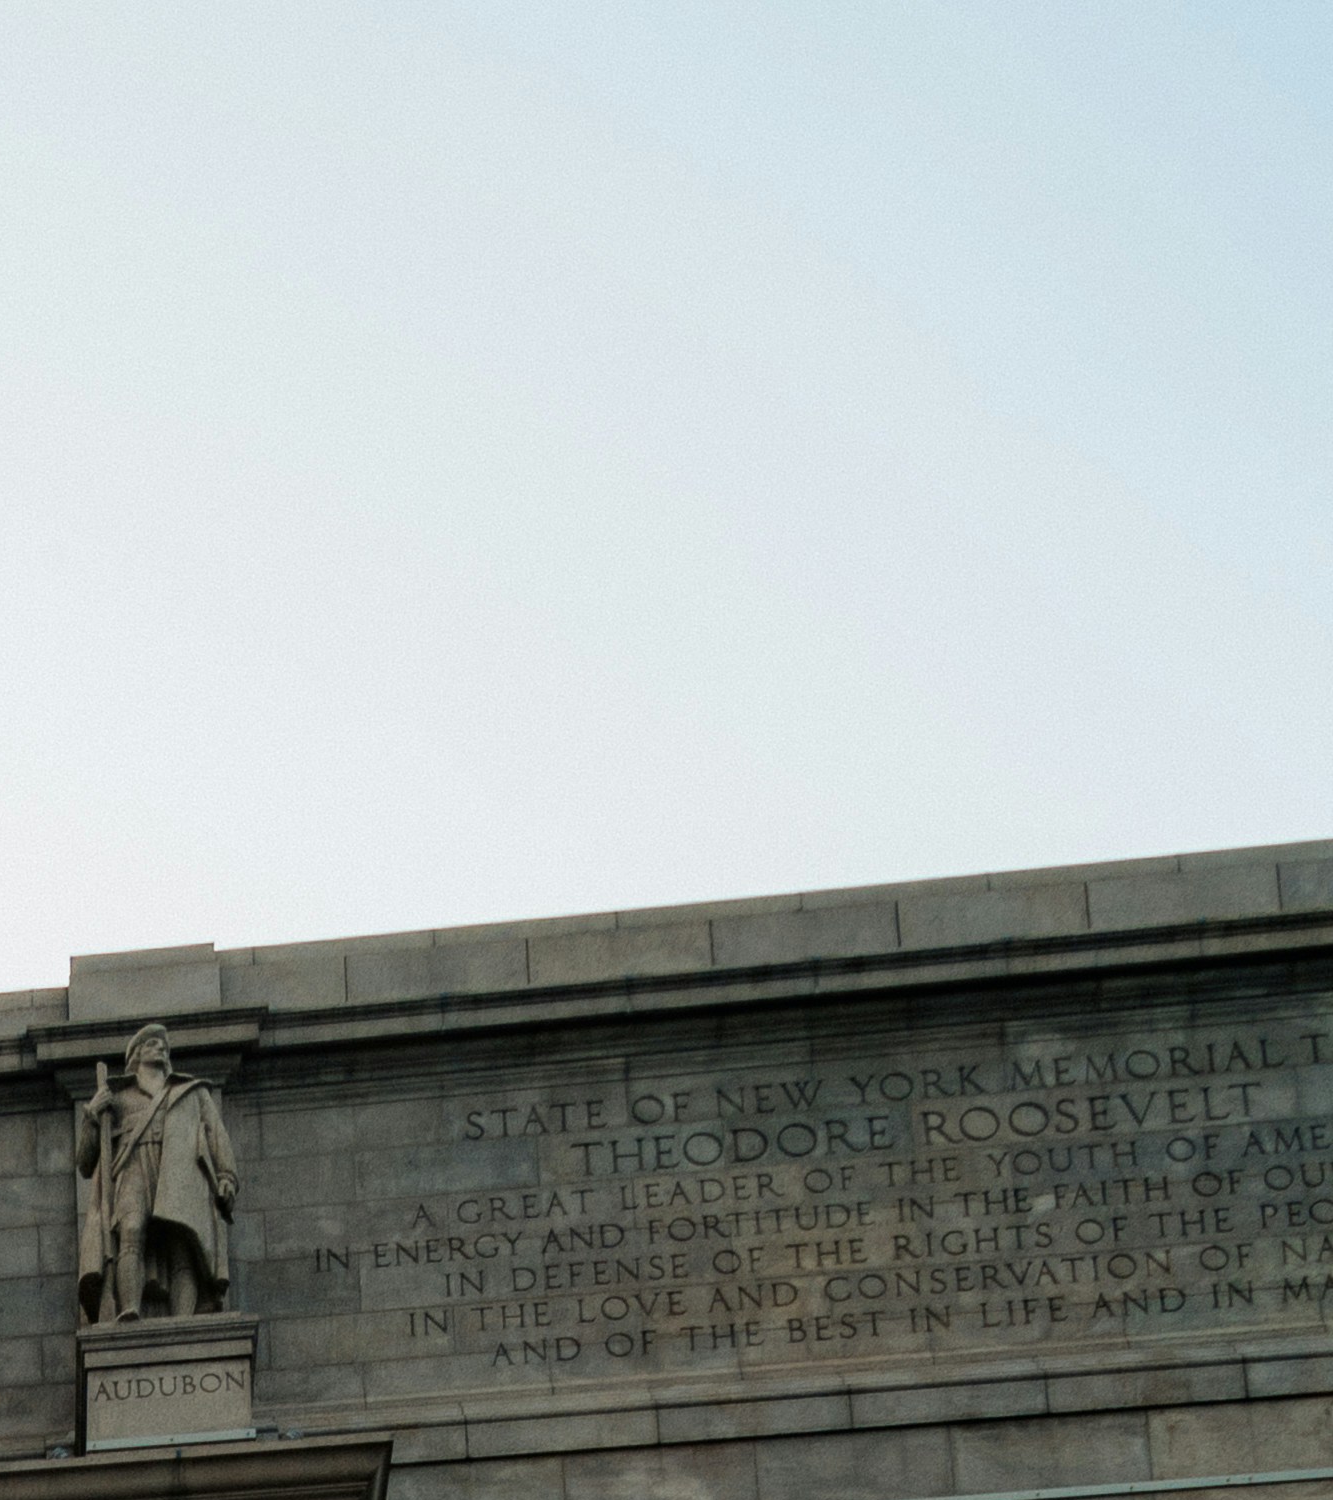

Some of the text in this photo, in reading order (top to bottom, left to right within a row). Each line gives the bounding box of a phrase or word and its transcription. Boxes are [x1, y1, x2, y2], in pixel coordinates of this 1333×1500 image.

[465, 1099, 608, 1141] STATE
[632, 1092, 692, 1127] OF
[717, 1079, 824, 1118] NEW
[850, 1065, 988, 1102] YORK
[1009, 1038, 1285, 1092] MEMORIAL
[571, 1082, 1262, 1177] THEODORE ROOSEVELT
[314, 1161, 1333, 1274] IN ENERGY AND FORTITUDE IN THE FAITH OF OU
[413, 1203, 434, 1230] A
[458, 1188, 595, 1225] GREAT
[621, 1171, 785, 1211] LEADER
[803, 1166, 856, 1194] OF
[879, 1157, 962, 1188] THE
[988, 1139, 1138, 1177] YOUTH
[1165, 1134, 1220, 1163] OF
[410, 1309, 450, 1337] IN
[472, 1302, 553, 1332] THE
[577, 1291, 688, 1324] LOVE
[708, 1281, 798, 1314] AND
[824, 1248, 1173, 1303] CONSERVATION
[1199, 1243, 1253, 1271] OF
[445, 1270, 485, 1298] IN
[512, 1253, 690, 1293] DEFENSE
[712, 1247, 763, 1276] OF
[785, 1234, 868, 1270] THE
[892, 1222, 1053, 1263] RIGHTS
[1075, 1215, 1128, 1245] OF
[1149, 1207, 1235, 1238] THE
[492, 1336, 582, 1367] AND
[605, 1330, 658, 1360] OF
[681, 1321, 765, 1352] THE
[788, 1311, 882, 1343] BEST
[910, 1305, 952, 1334] IN
[979, 1297, 1069, 1329] LIFE
[1092, 1287, 1186, 1319] AND
[1212, 1280, 1254, 1309] IN
[93, 1369, 247, 1402] AUDUBON
